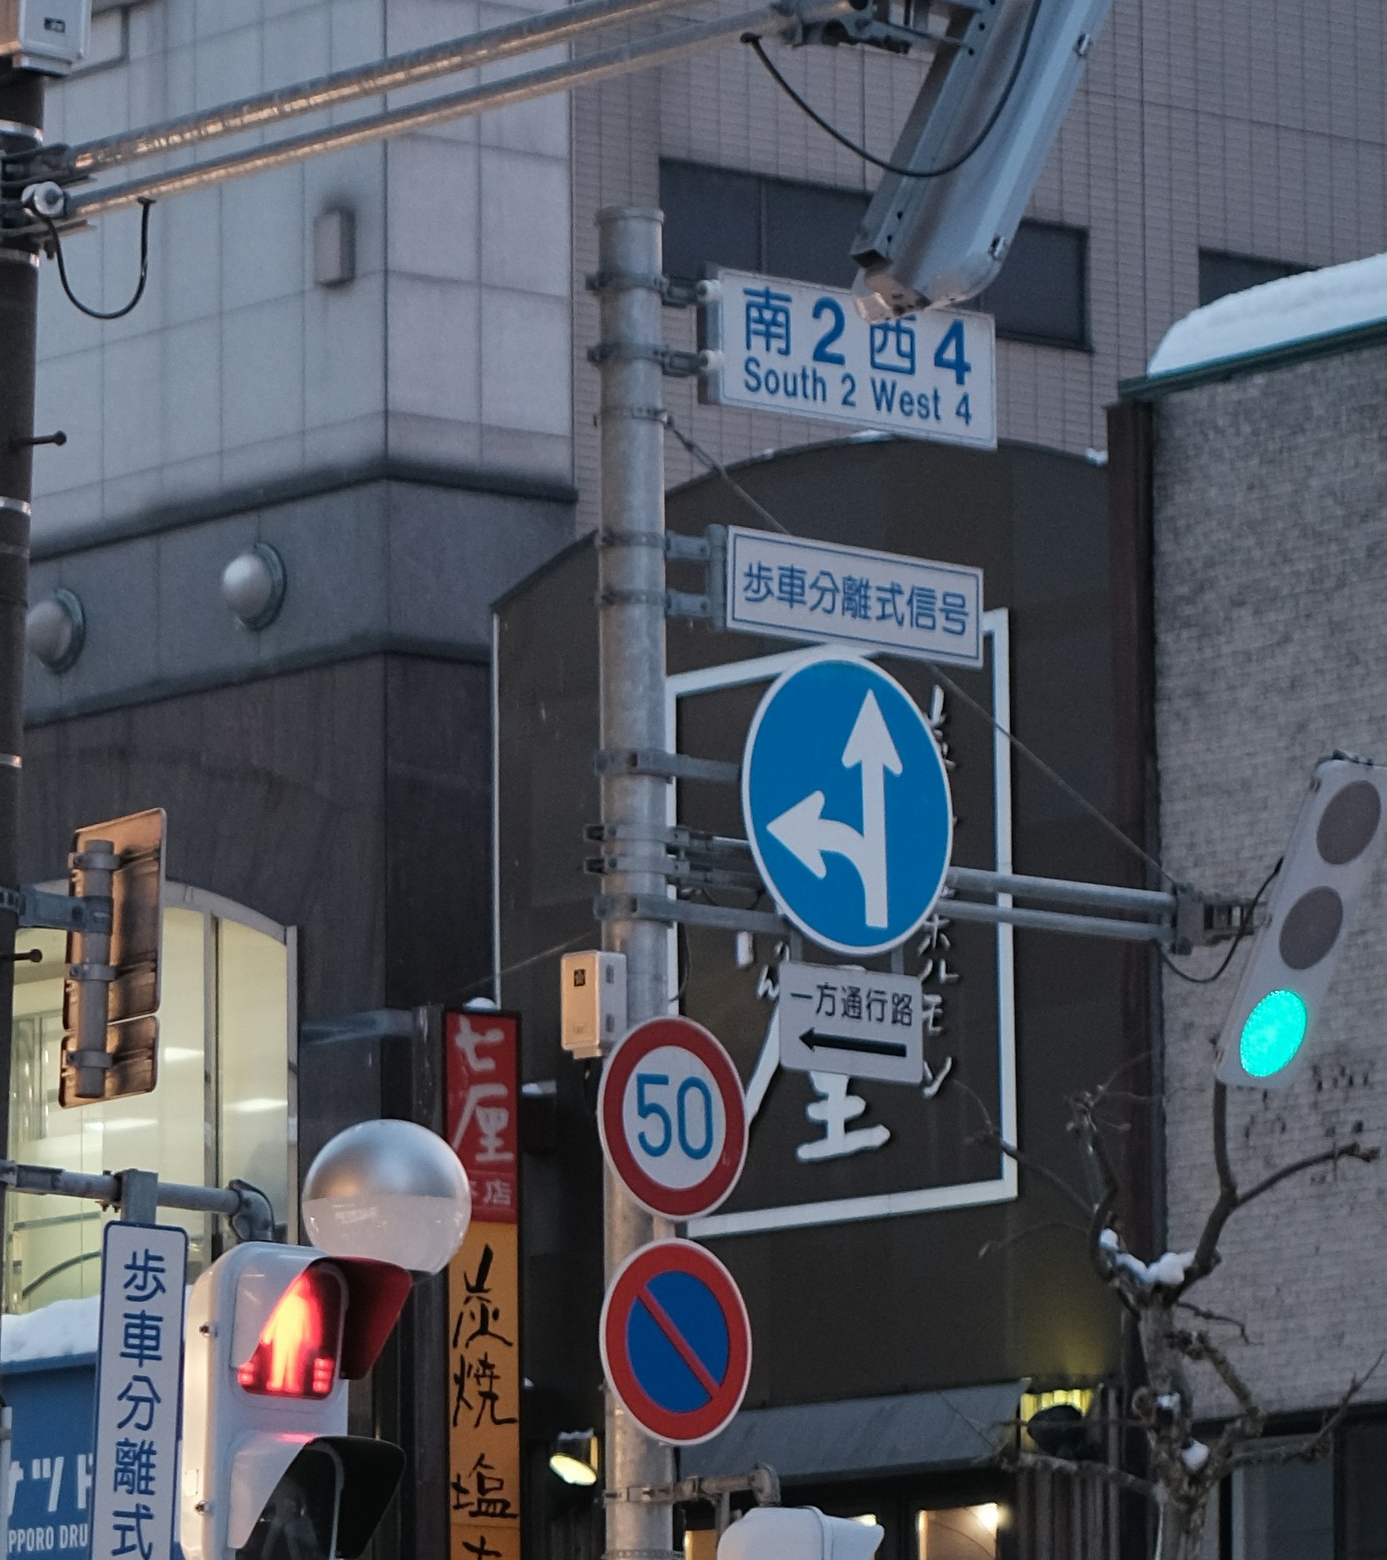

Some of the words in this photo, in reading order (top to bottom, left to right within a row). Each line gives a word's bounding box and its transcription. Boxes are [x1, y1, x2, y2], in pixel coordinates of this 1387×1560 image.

[744, 355, 827, 403] South
[841, 372, 856, 407] 2
[871, 376, 941, 421] West
[955, 391, 972, 426] 4
[741, 556, 973, 638] 歩車分離式信号
[790, 983, 914, 1027] 一方通行路
[637, 1072, 714, 1161] 50
[59, 1522, 89, 1549] DRU
